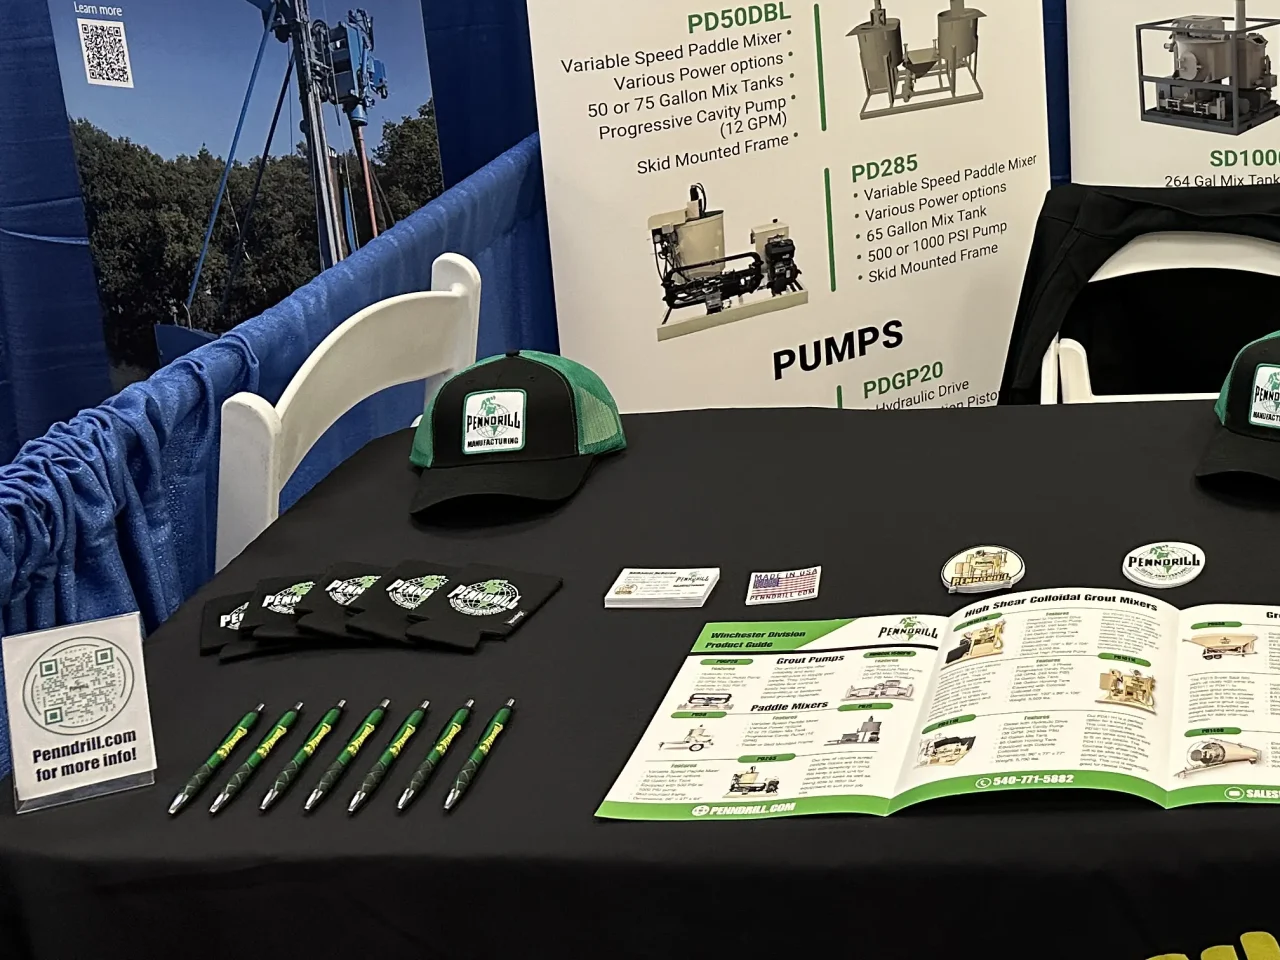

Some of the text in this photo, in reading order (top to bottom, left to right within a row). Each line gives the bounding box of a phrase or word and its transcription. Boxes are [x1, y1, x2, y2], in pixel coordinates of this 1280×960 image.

[688, 1, 792, 34] PD50DBL
[637, 135, 789, 175] Skid Mounted Frame
[851, 154, 919, 183] PD285
[868, 222, 1007, 263] 500 or 1000 PSI Pump
[773, 319, 904, 381] PUMPS
[863, 361, 944, 399] PDGP20
[466, 411, 521, 433] PENNDRILL
[467, 437, 519, 448] MANUFACTURING
[1128, 552, 1201, 568] PENNDRILL
[447, 583, 523, 610] PENNDRILL
[964, 593, 1158, 618] High Shear Colloidal Grout Mixers
[878, 626, 939, 639] PENNDRILL
[776, 655, 845, 665] Grout Pumps
[750, 701, 828, 712] Paddle Mixers
[32, 728, 137, 763] Penndrill.com
[35, 747, 137, 783] for more info!
[993, 774, 1074, 786] 540-771-5882
[709, 802, 796, 816] PENNDRILL.COM
